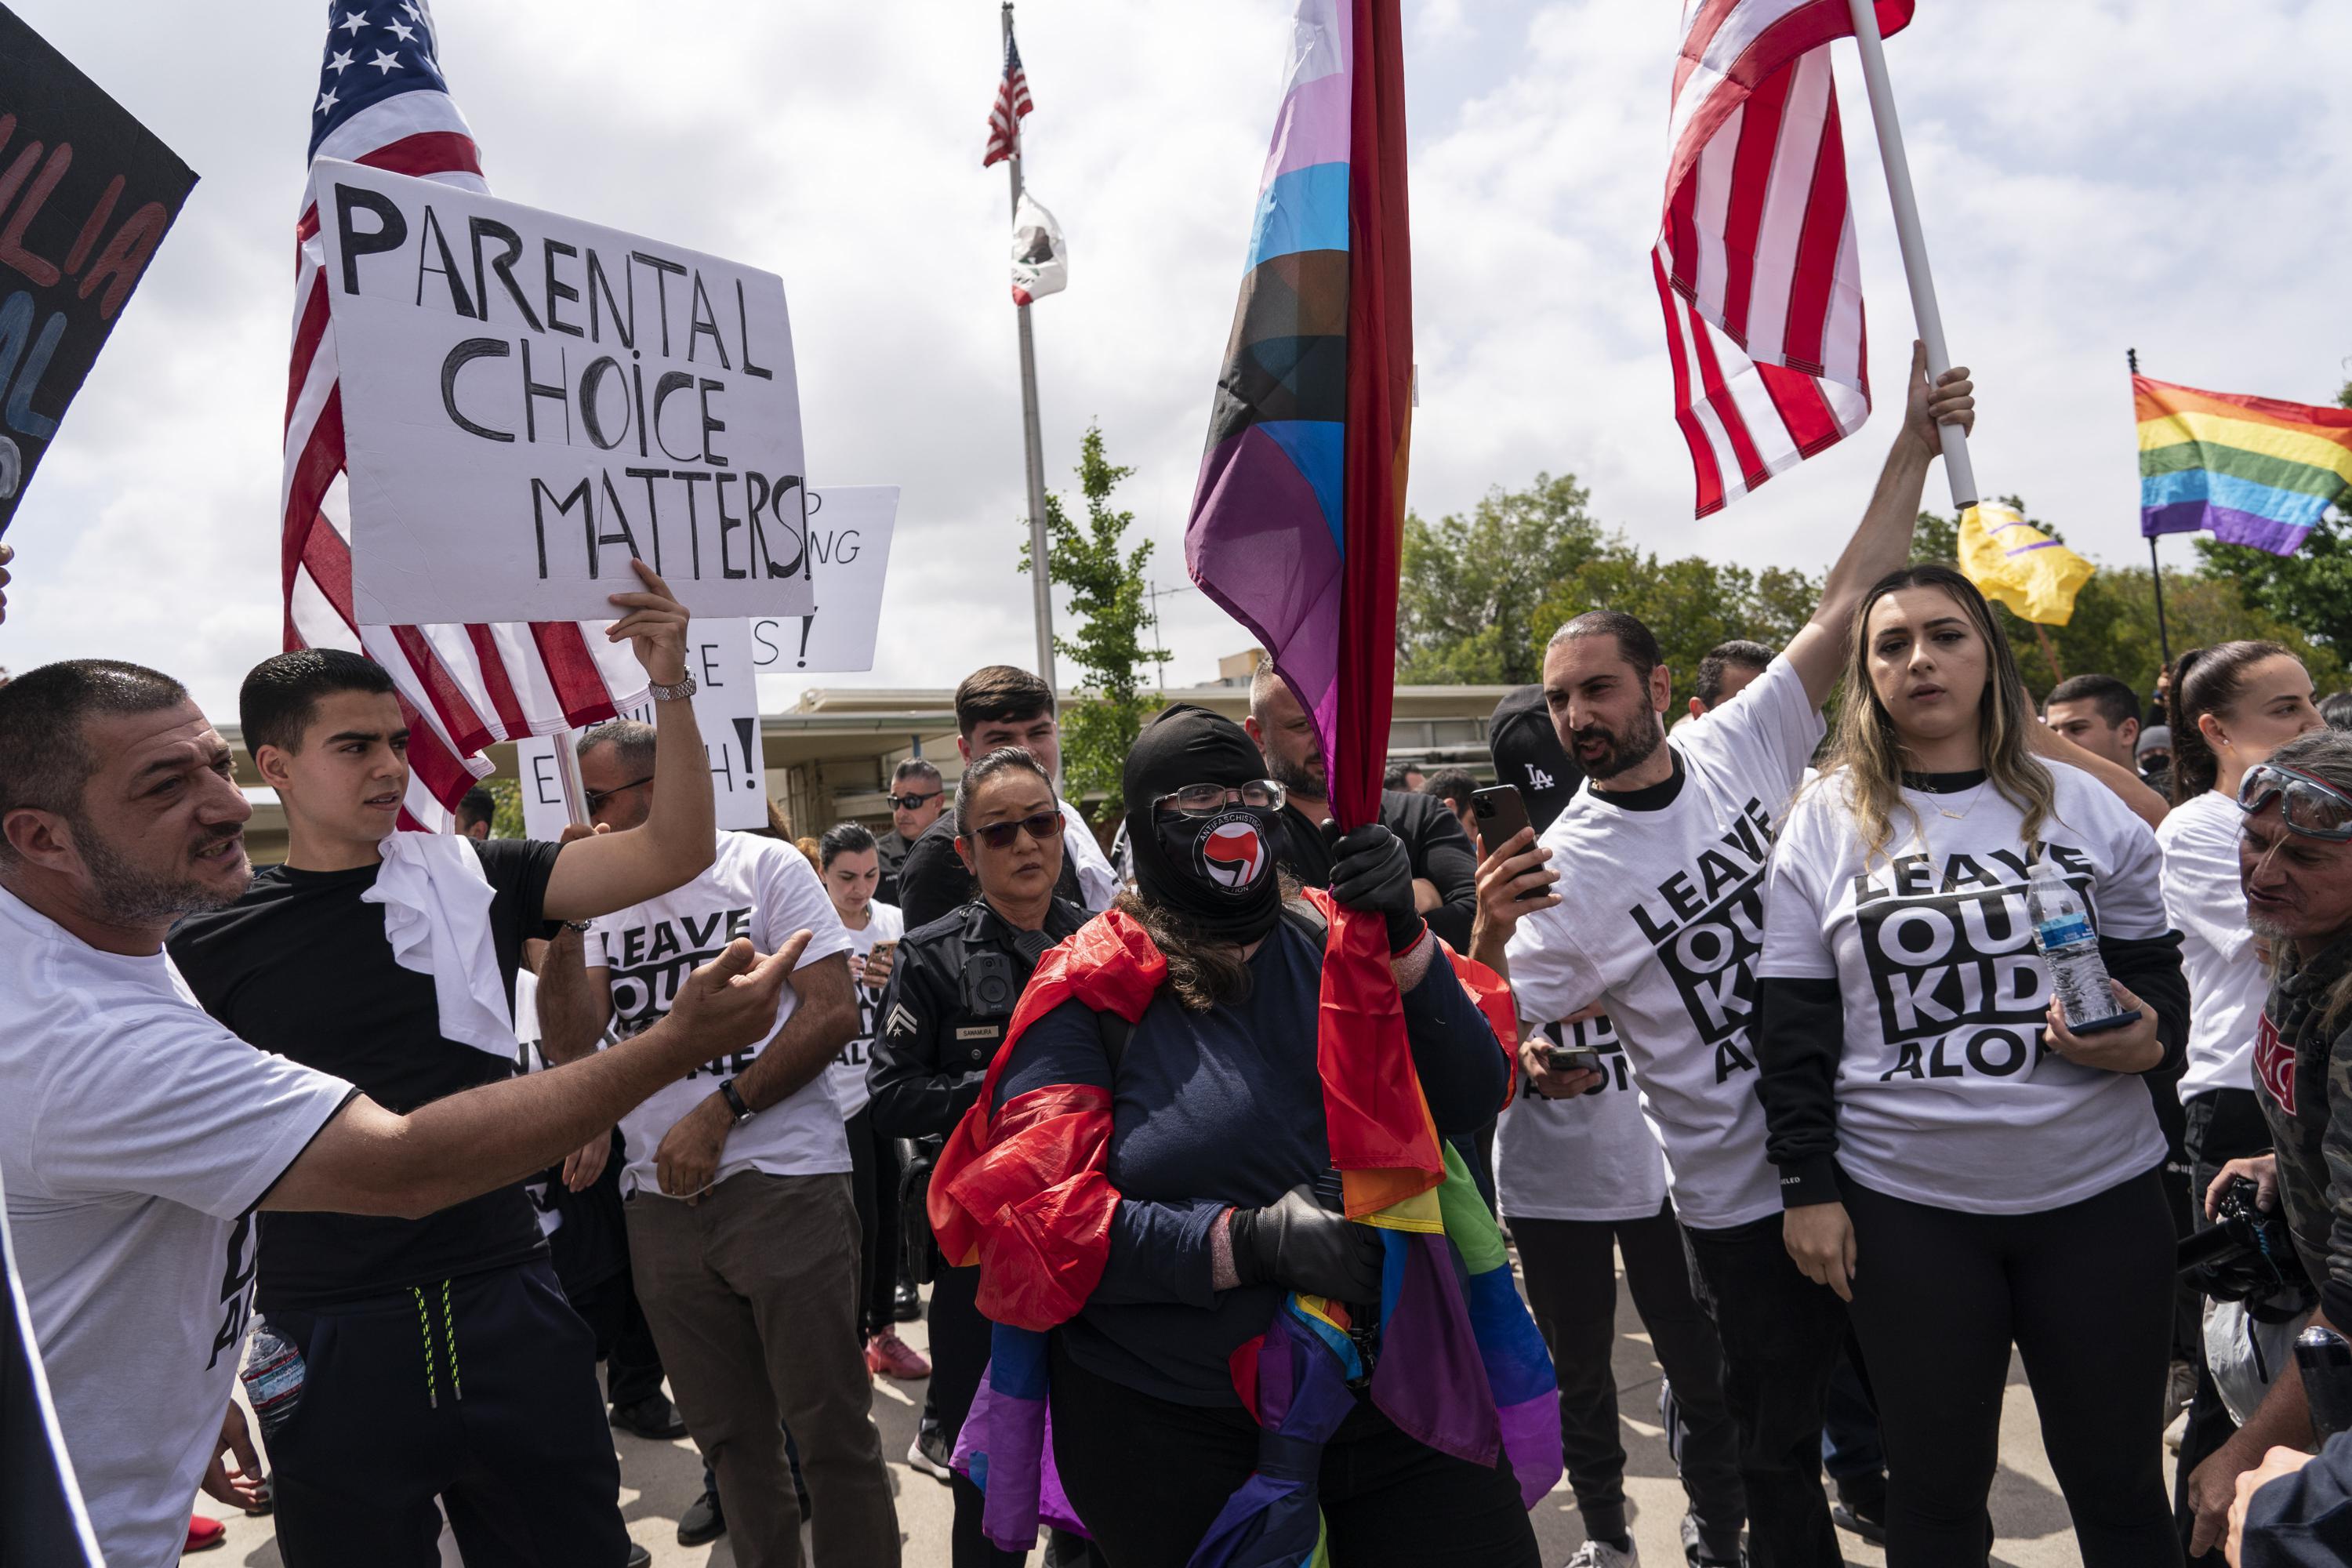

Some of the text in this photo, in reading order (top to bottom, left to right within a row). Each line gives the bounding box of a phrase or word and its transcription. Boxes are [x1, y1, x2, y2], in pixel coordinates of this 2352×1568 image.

[0, 113, 167, 320] ILIA
[335, 183, 773, 380] PARENTAL
[530, 467, 811, 581] MATTERS!
[1524, 764, 1555, 790] LA
[1628, 796, 1777, 946] LEAVE
[1854, 840, 2094, 899] LEAVE
[601, 906, 752, 968] LEAVE
